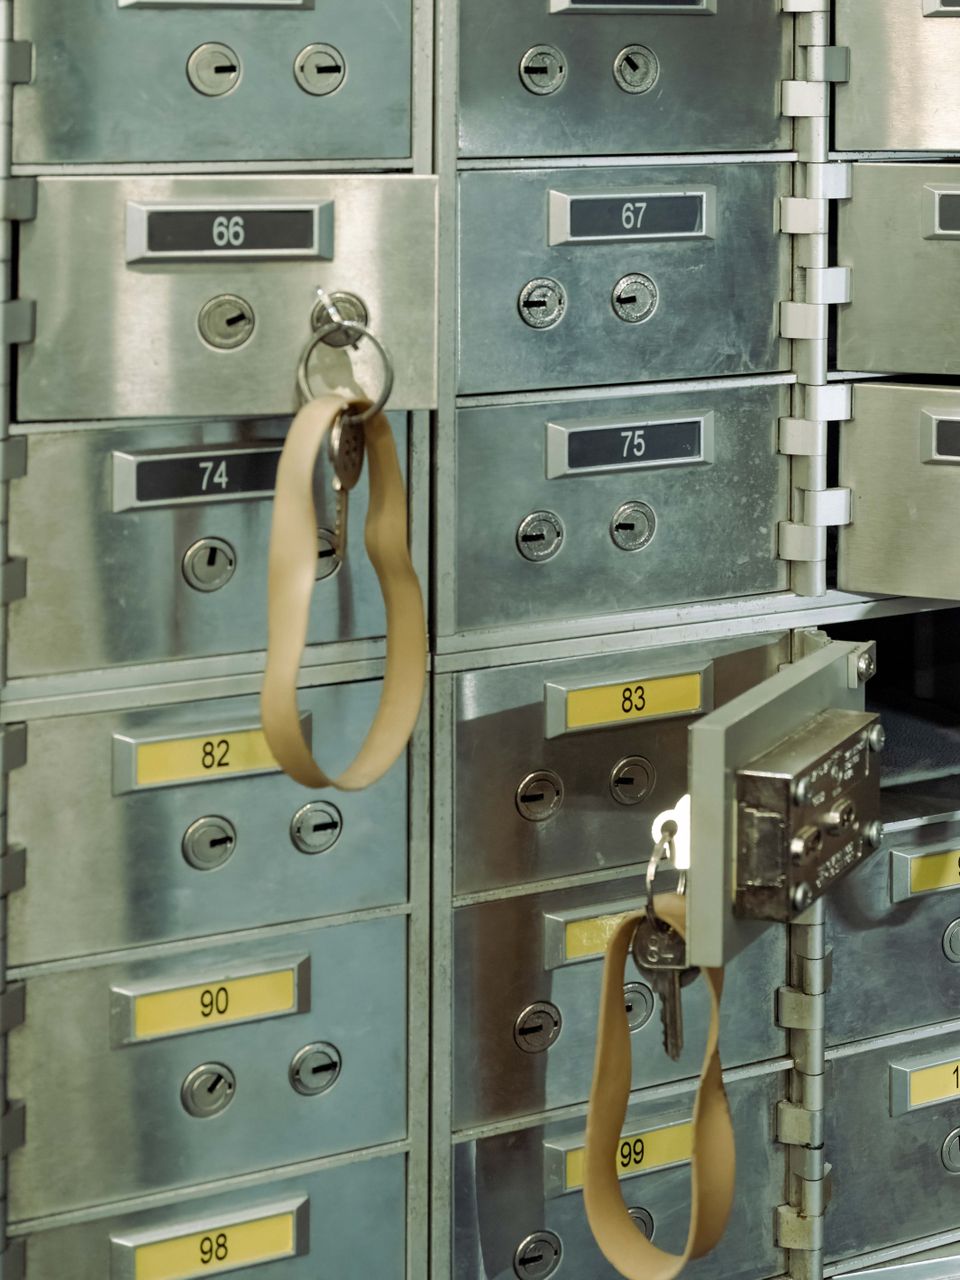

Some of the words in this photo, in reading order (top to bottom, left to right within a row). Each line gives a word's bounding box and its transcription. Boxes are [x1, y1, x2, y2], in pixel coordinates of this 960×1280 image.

[621, 203, 646, 229] 67
[212, 217, 244, 246] 66
[620, 430, 645, 458] 75
[199, 461, 228, 491] 74
[622, 686, 645, 713] 83
[202, 740, 229, 768] 82
[201, 987, 228, 1017] 90
[621, 1139, 644, 1167] 99
[200, 1233, 227, 1264] 98
